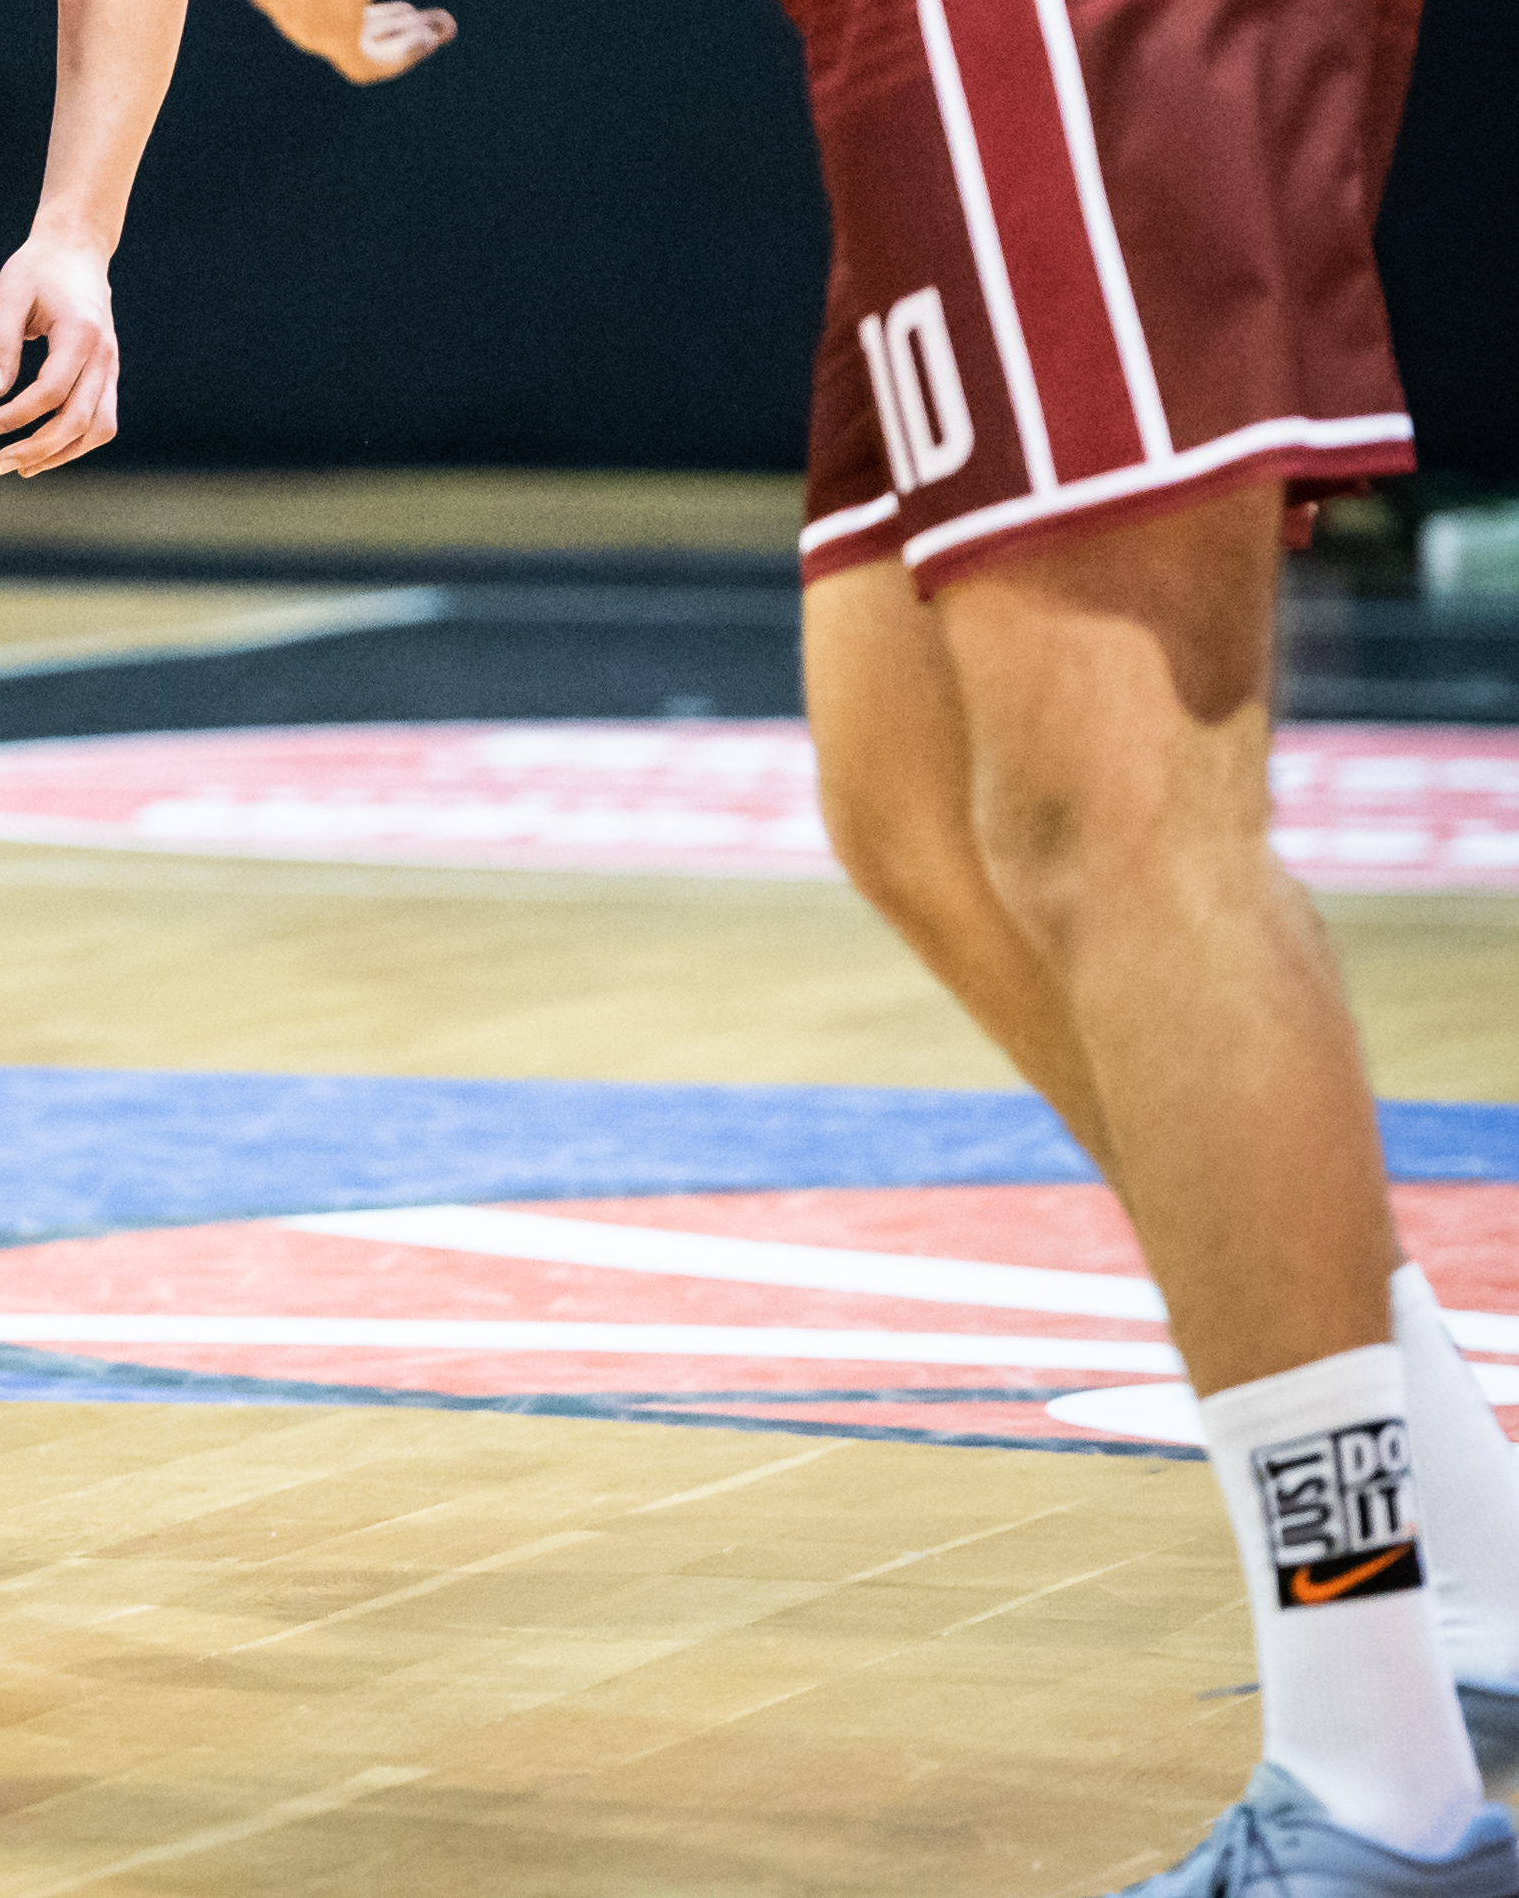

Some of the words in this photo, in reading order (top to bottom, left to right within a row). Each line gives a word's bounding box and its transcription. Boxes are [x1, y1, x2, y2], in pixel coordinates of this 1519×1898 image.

[857, 285, 975, 494] 10
[1339, 1424, 1411, 1486] DO
[1265, 1448, 1335, 1558] JUST
[1355, 1484, 1404, 1542] IT
